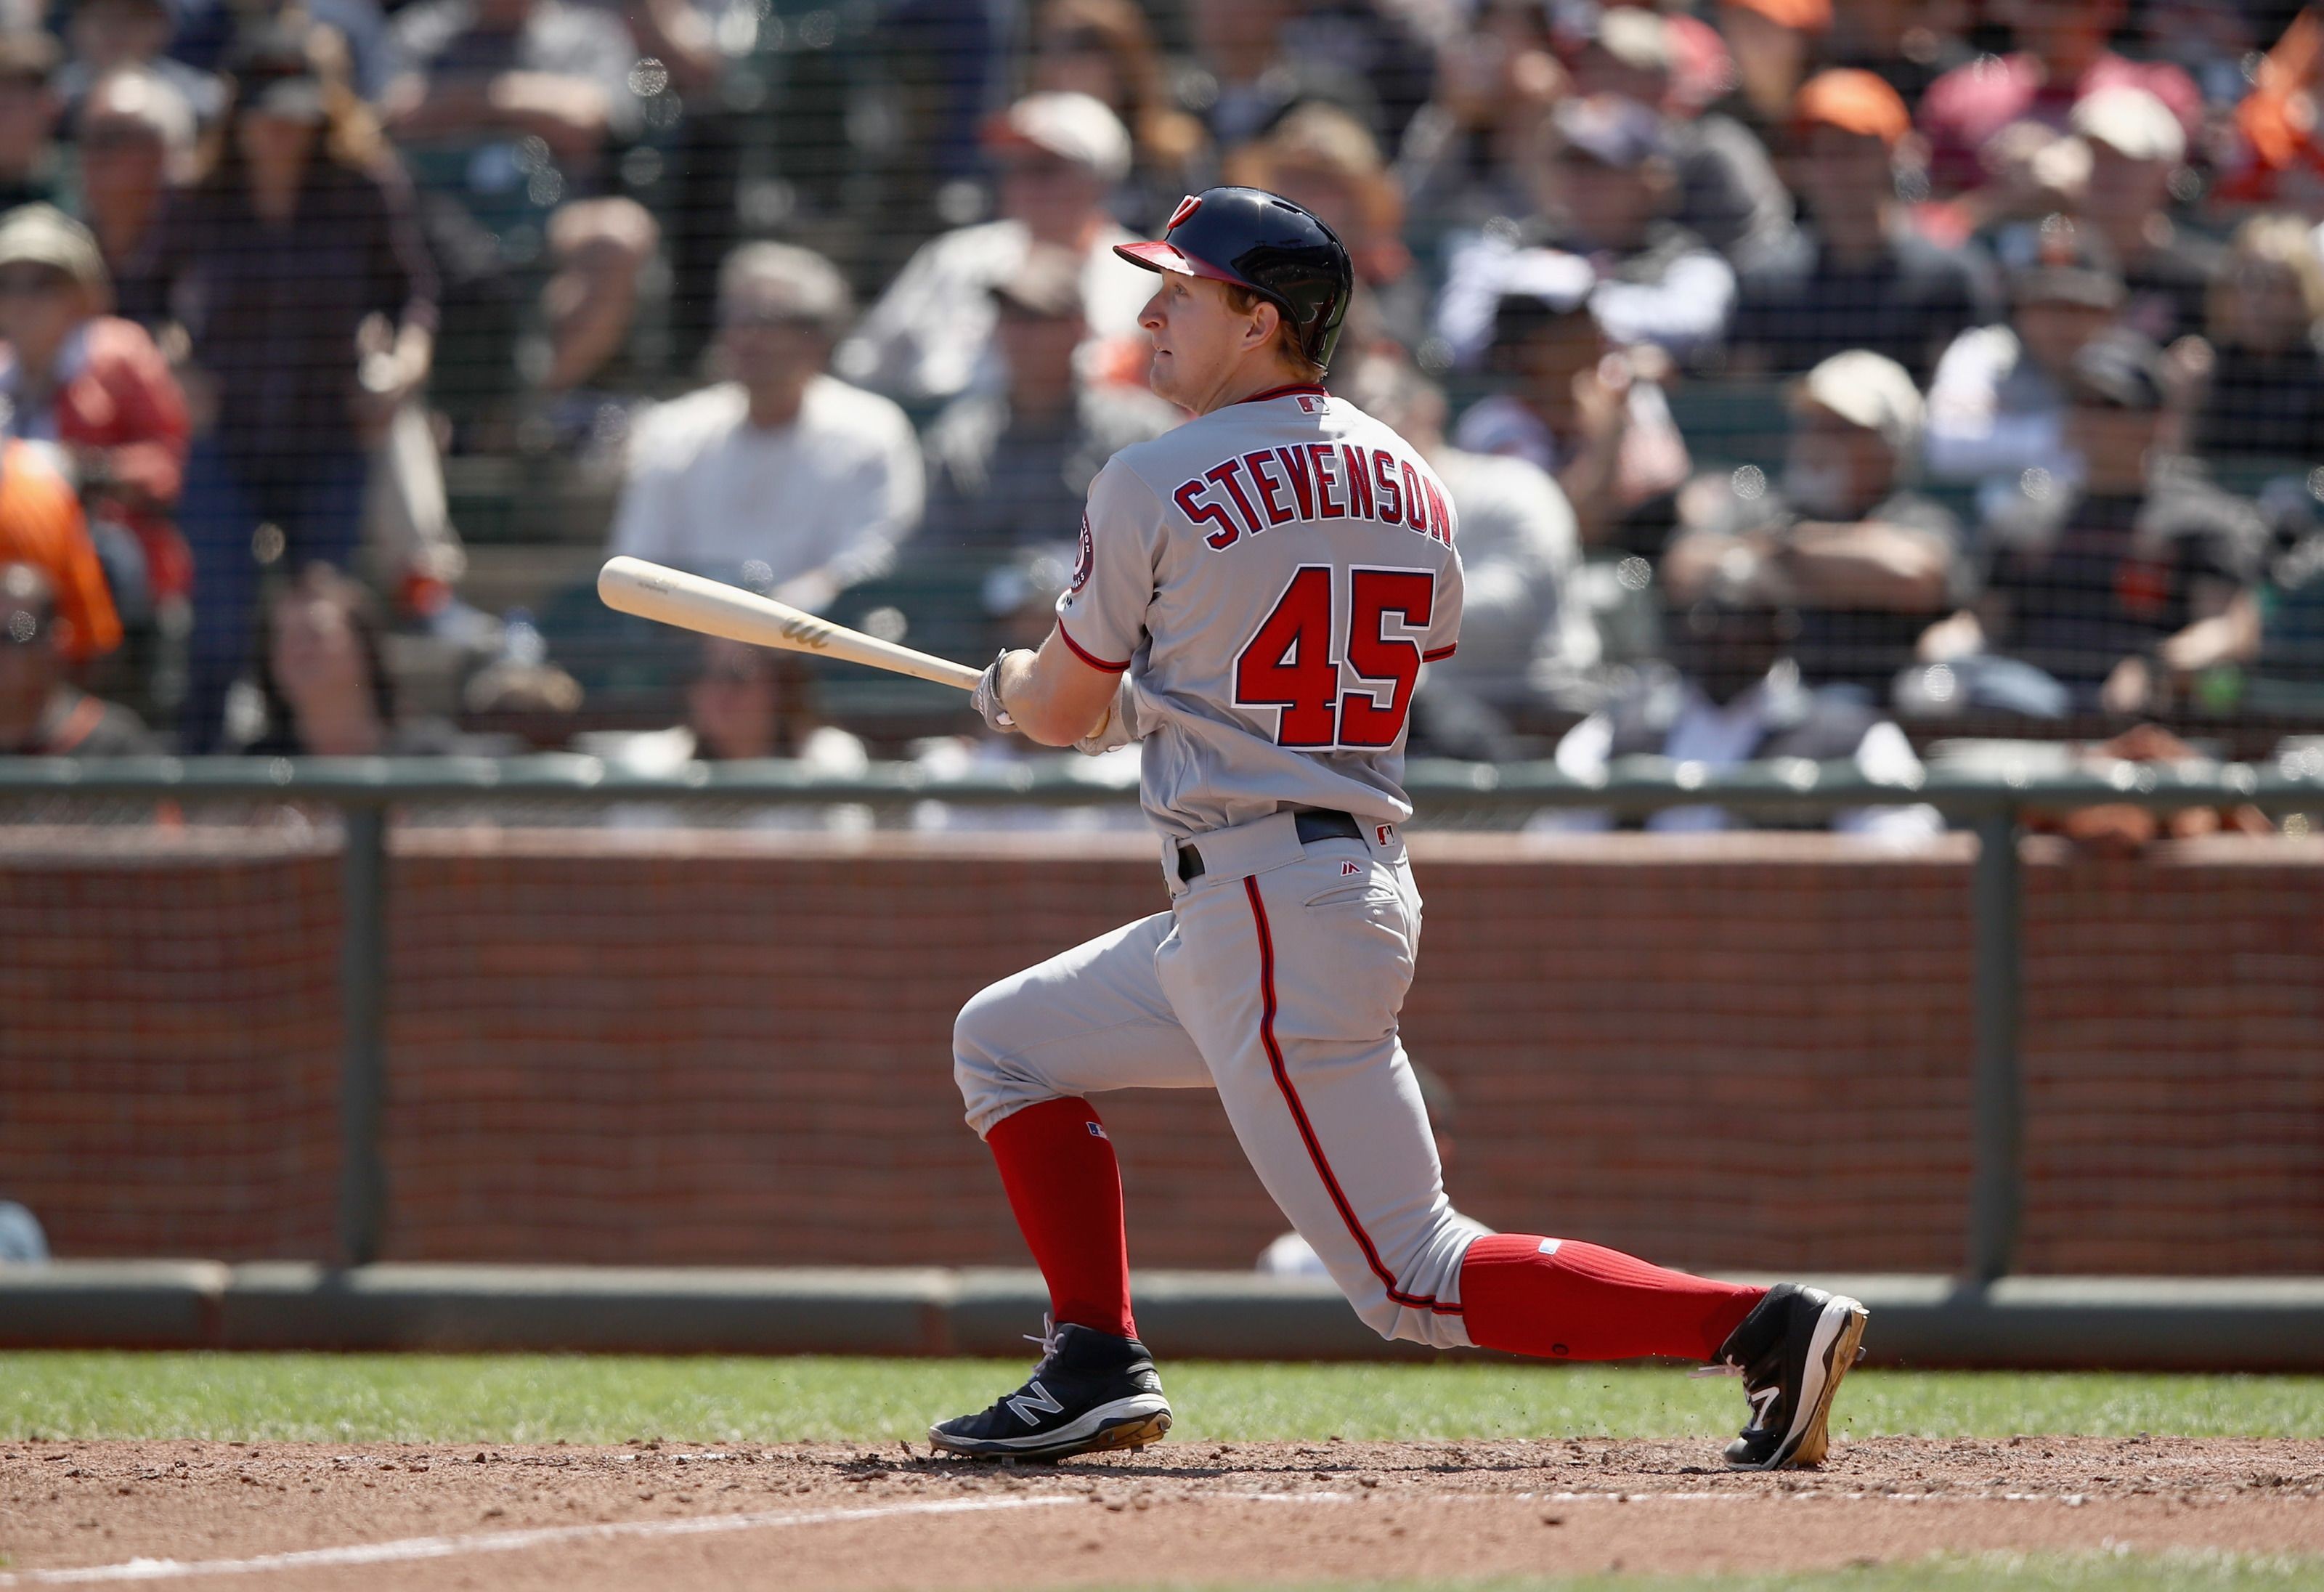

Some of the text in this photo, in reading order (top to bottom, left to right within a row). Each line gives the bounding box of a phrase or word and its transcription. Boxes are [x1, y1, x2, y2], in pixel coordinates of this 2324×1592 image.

[1172, 442, 1452, 552] STEVENSON
[1231, 564, 1437, 751] 45
[1006, 1381, 1065, 1426] N
